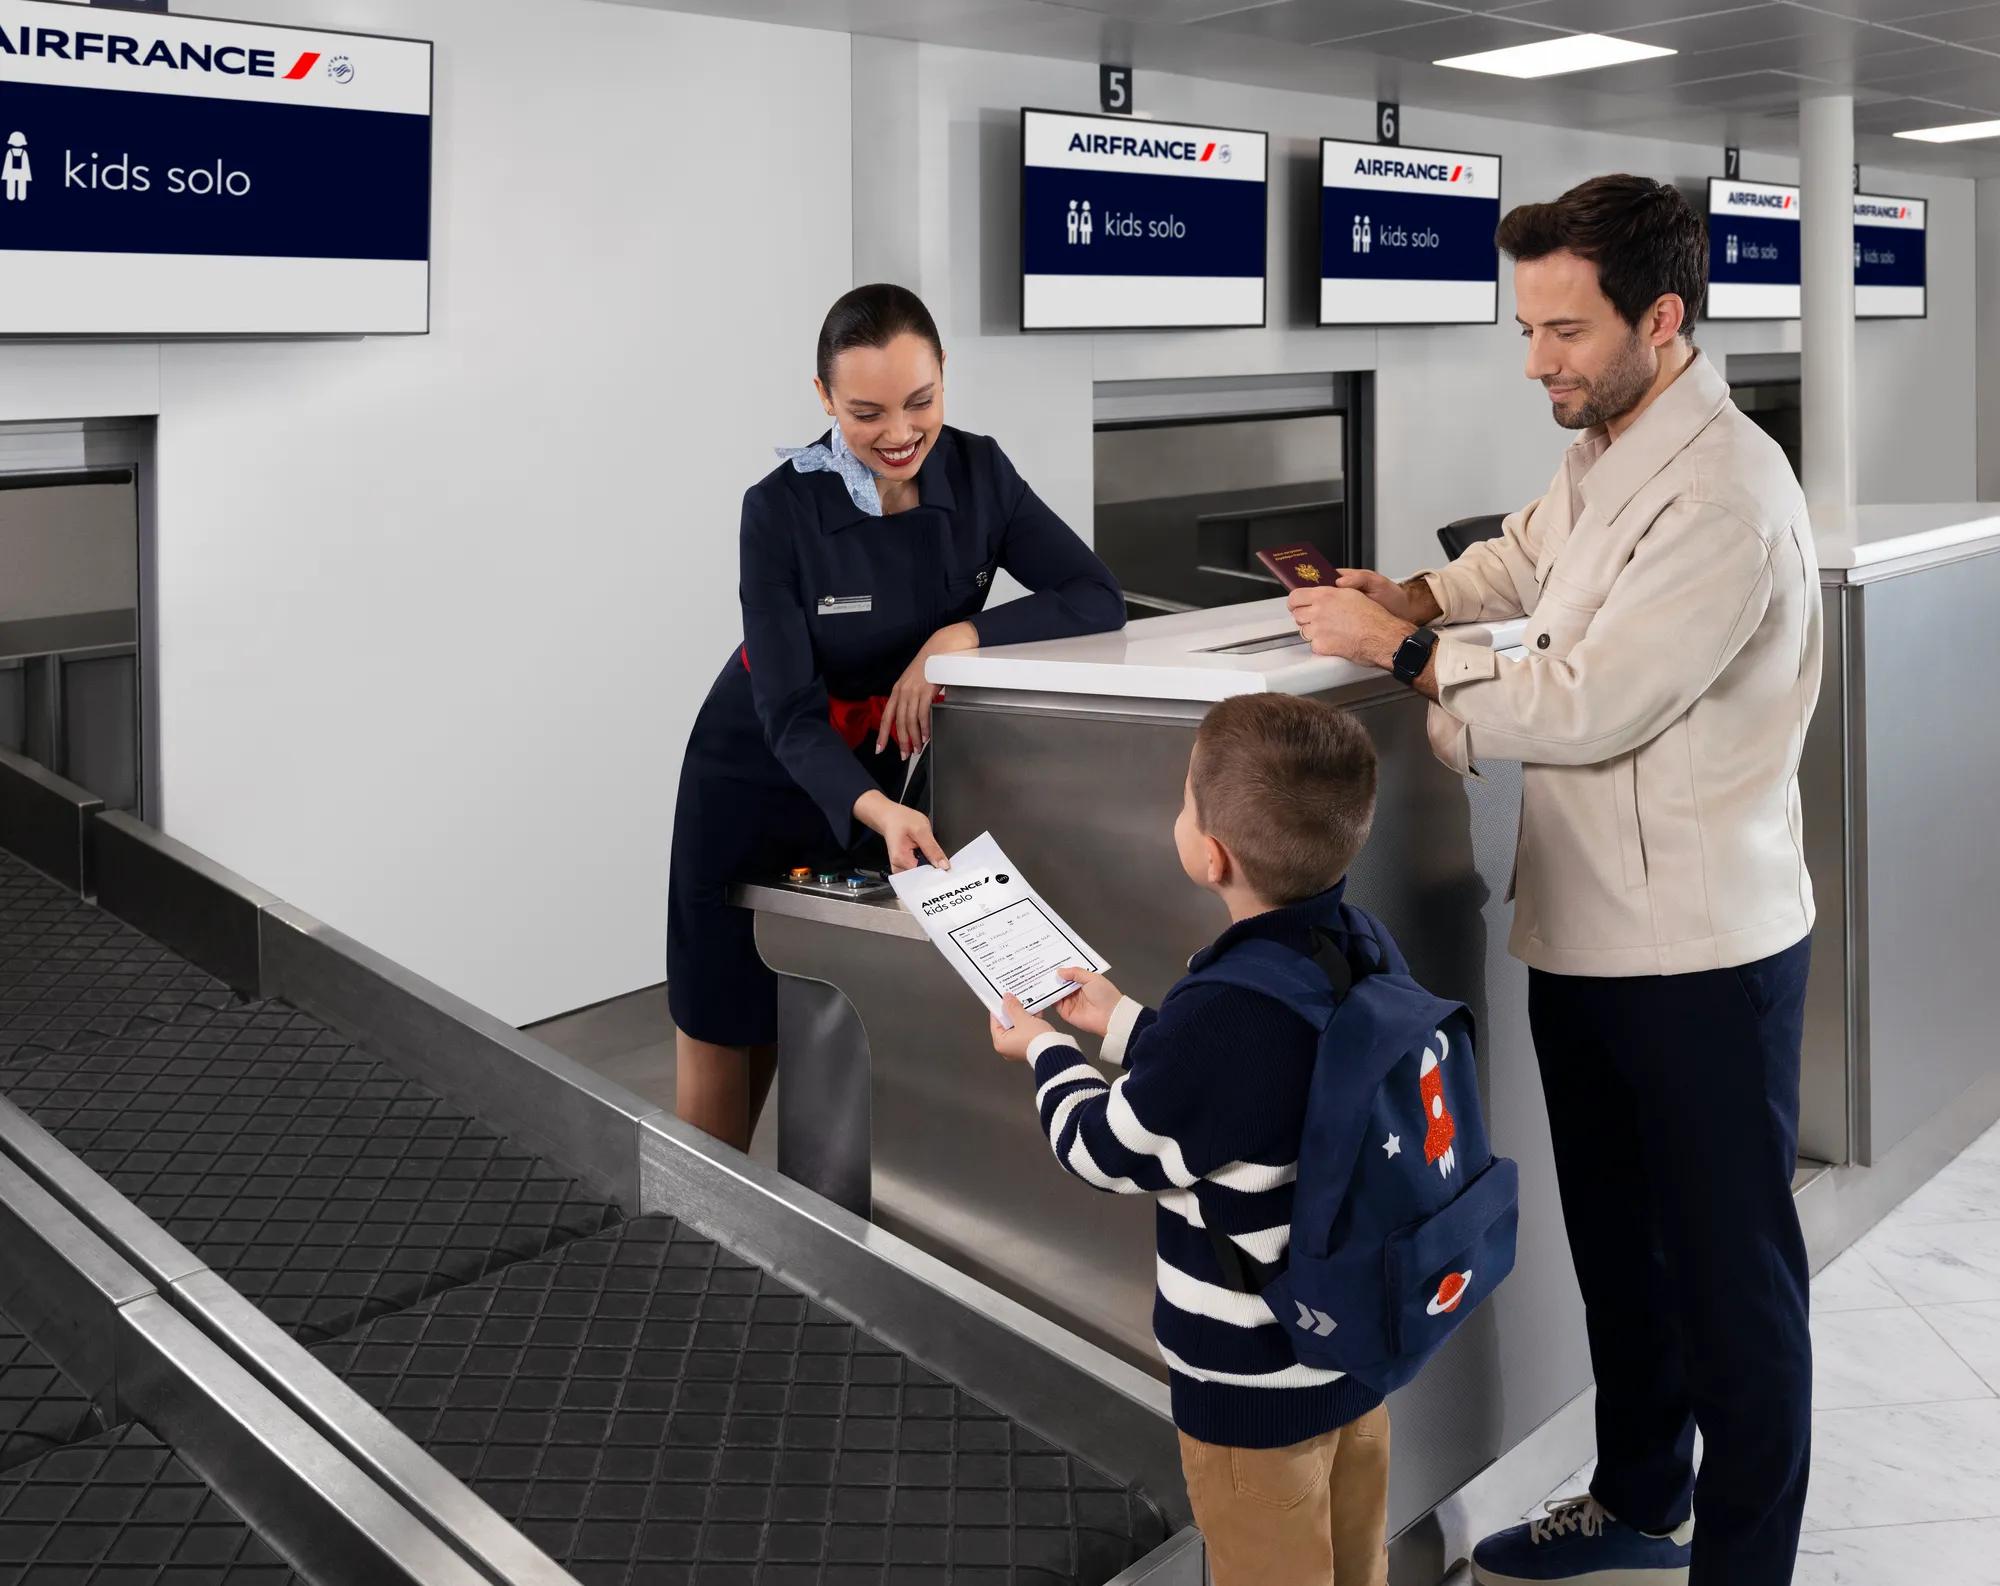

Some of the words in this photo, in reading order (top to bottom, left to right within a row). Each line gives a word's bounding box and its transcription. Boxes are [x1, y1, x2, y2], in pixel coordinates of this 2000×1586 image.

[1109, 72, 1126, 108] 5
[1382, 108, 1395, 139] 6
[1068, 132, 1197, 161] AIRFRANCE
[65, 149, 151, 192] kids
[167, 158, 251, 196] solo
[1354, 158, 1448, 182] AIRFRANCE
[1728, 151, 1738, 175] 7
[1728, 192, 1783, 209] AIRFRANCE
[1105, 211, 1142, 237] kids
[1149, 214, 1186, 239] solo
[1379, 225, 1407, 247] kids
[1411, 227, 1440, 249] solo
[1742, 243, 1759, 259] kids
[1760, 243, 1778, 260] solo
[922, 881, 982, 908] AIRFRANCE
[924, 904, 949, 917] kids
[950, 894, 973, 907] solo
